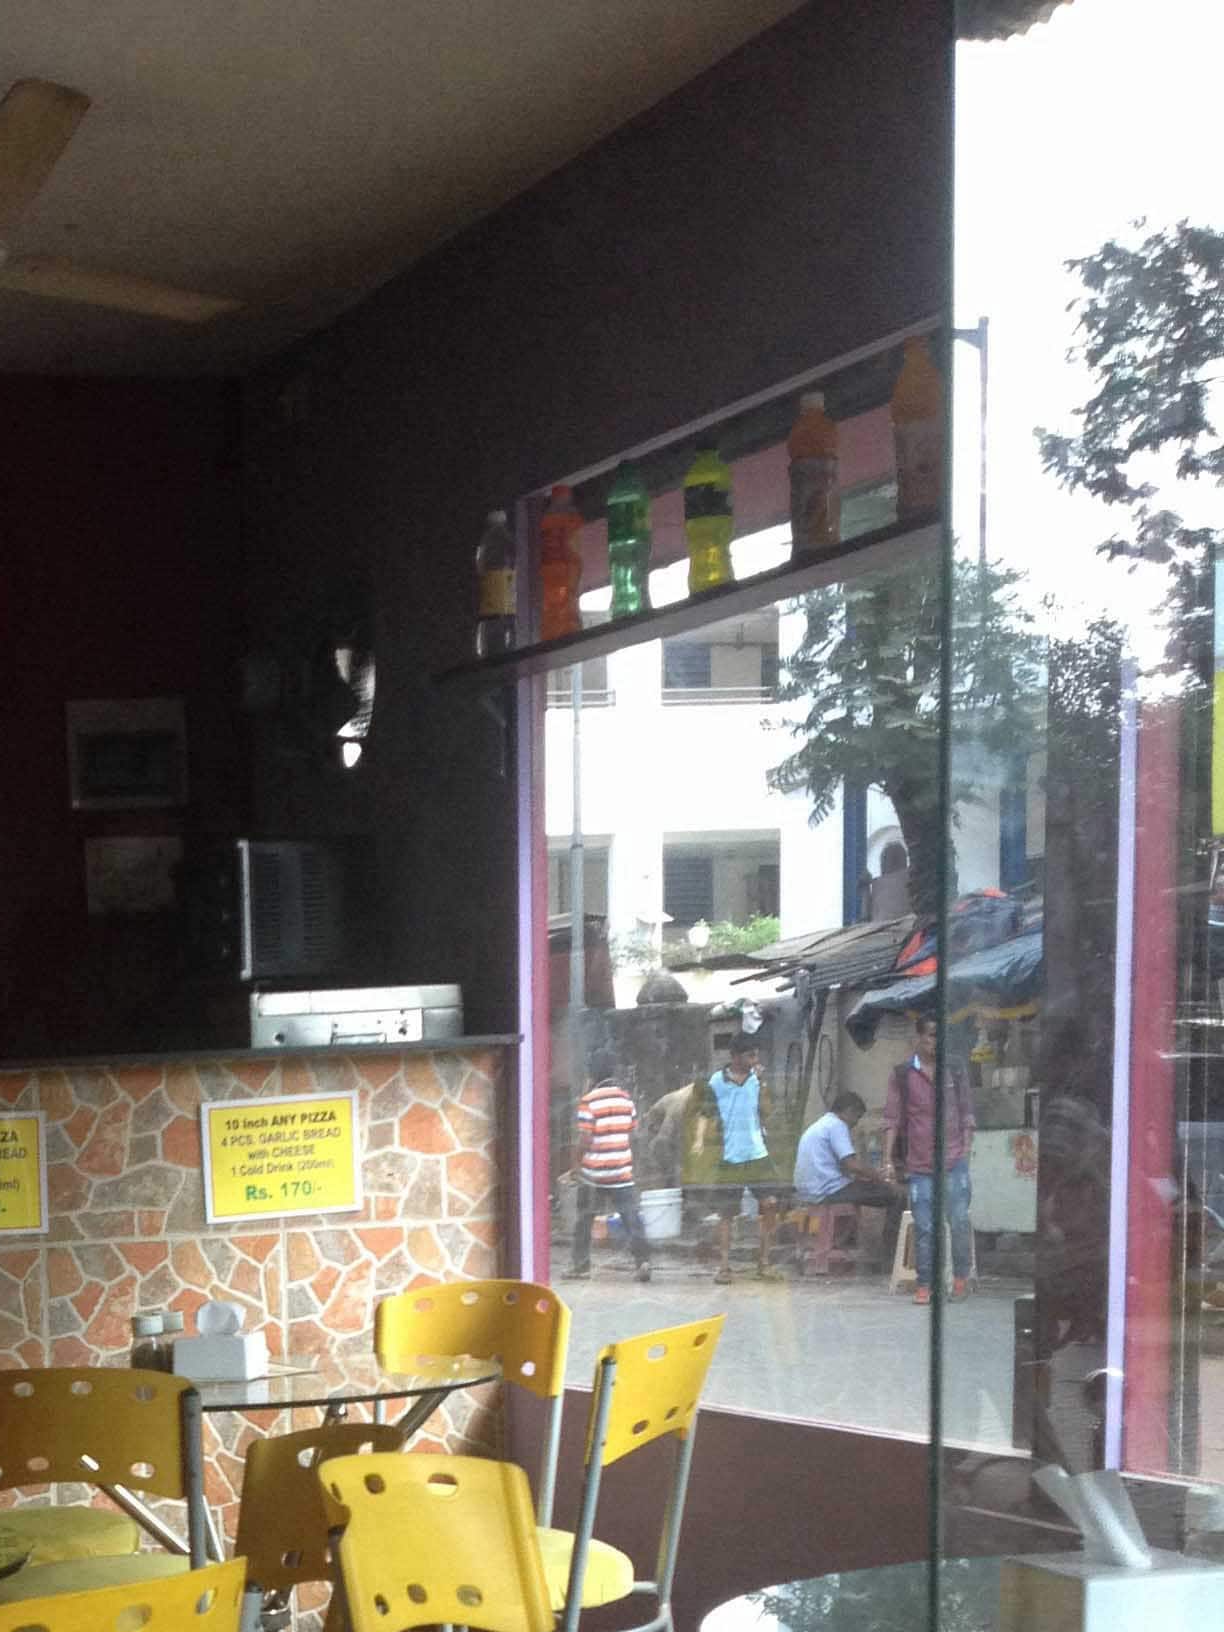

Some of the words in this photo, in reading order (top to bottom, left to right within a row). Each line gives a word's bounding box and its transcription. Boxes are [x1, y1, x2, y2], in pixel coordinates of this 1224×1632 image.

[225, 1119, 240, 1131] 10
[270, 1114, 297, 1127] ANY
[300, 1110, 337, 1123] PIZZA
[259, 1131, 299, 1145] GARLIC
[303, 1127, 341, 1141] BREAD
[248, 1148, 269, 1160] with
[271, 1144, 315, 1158] CHEESE
[239, 1164, 264, 1177] Cold
[266, 1161, 293, 1174] Drink
[245, 1185, 273, 1201] Rs.
